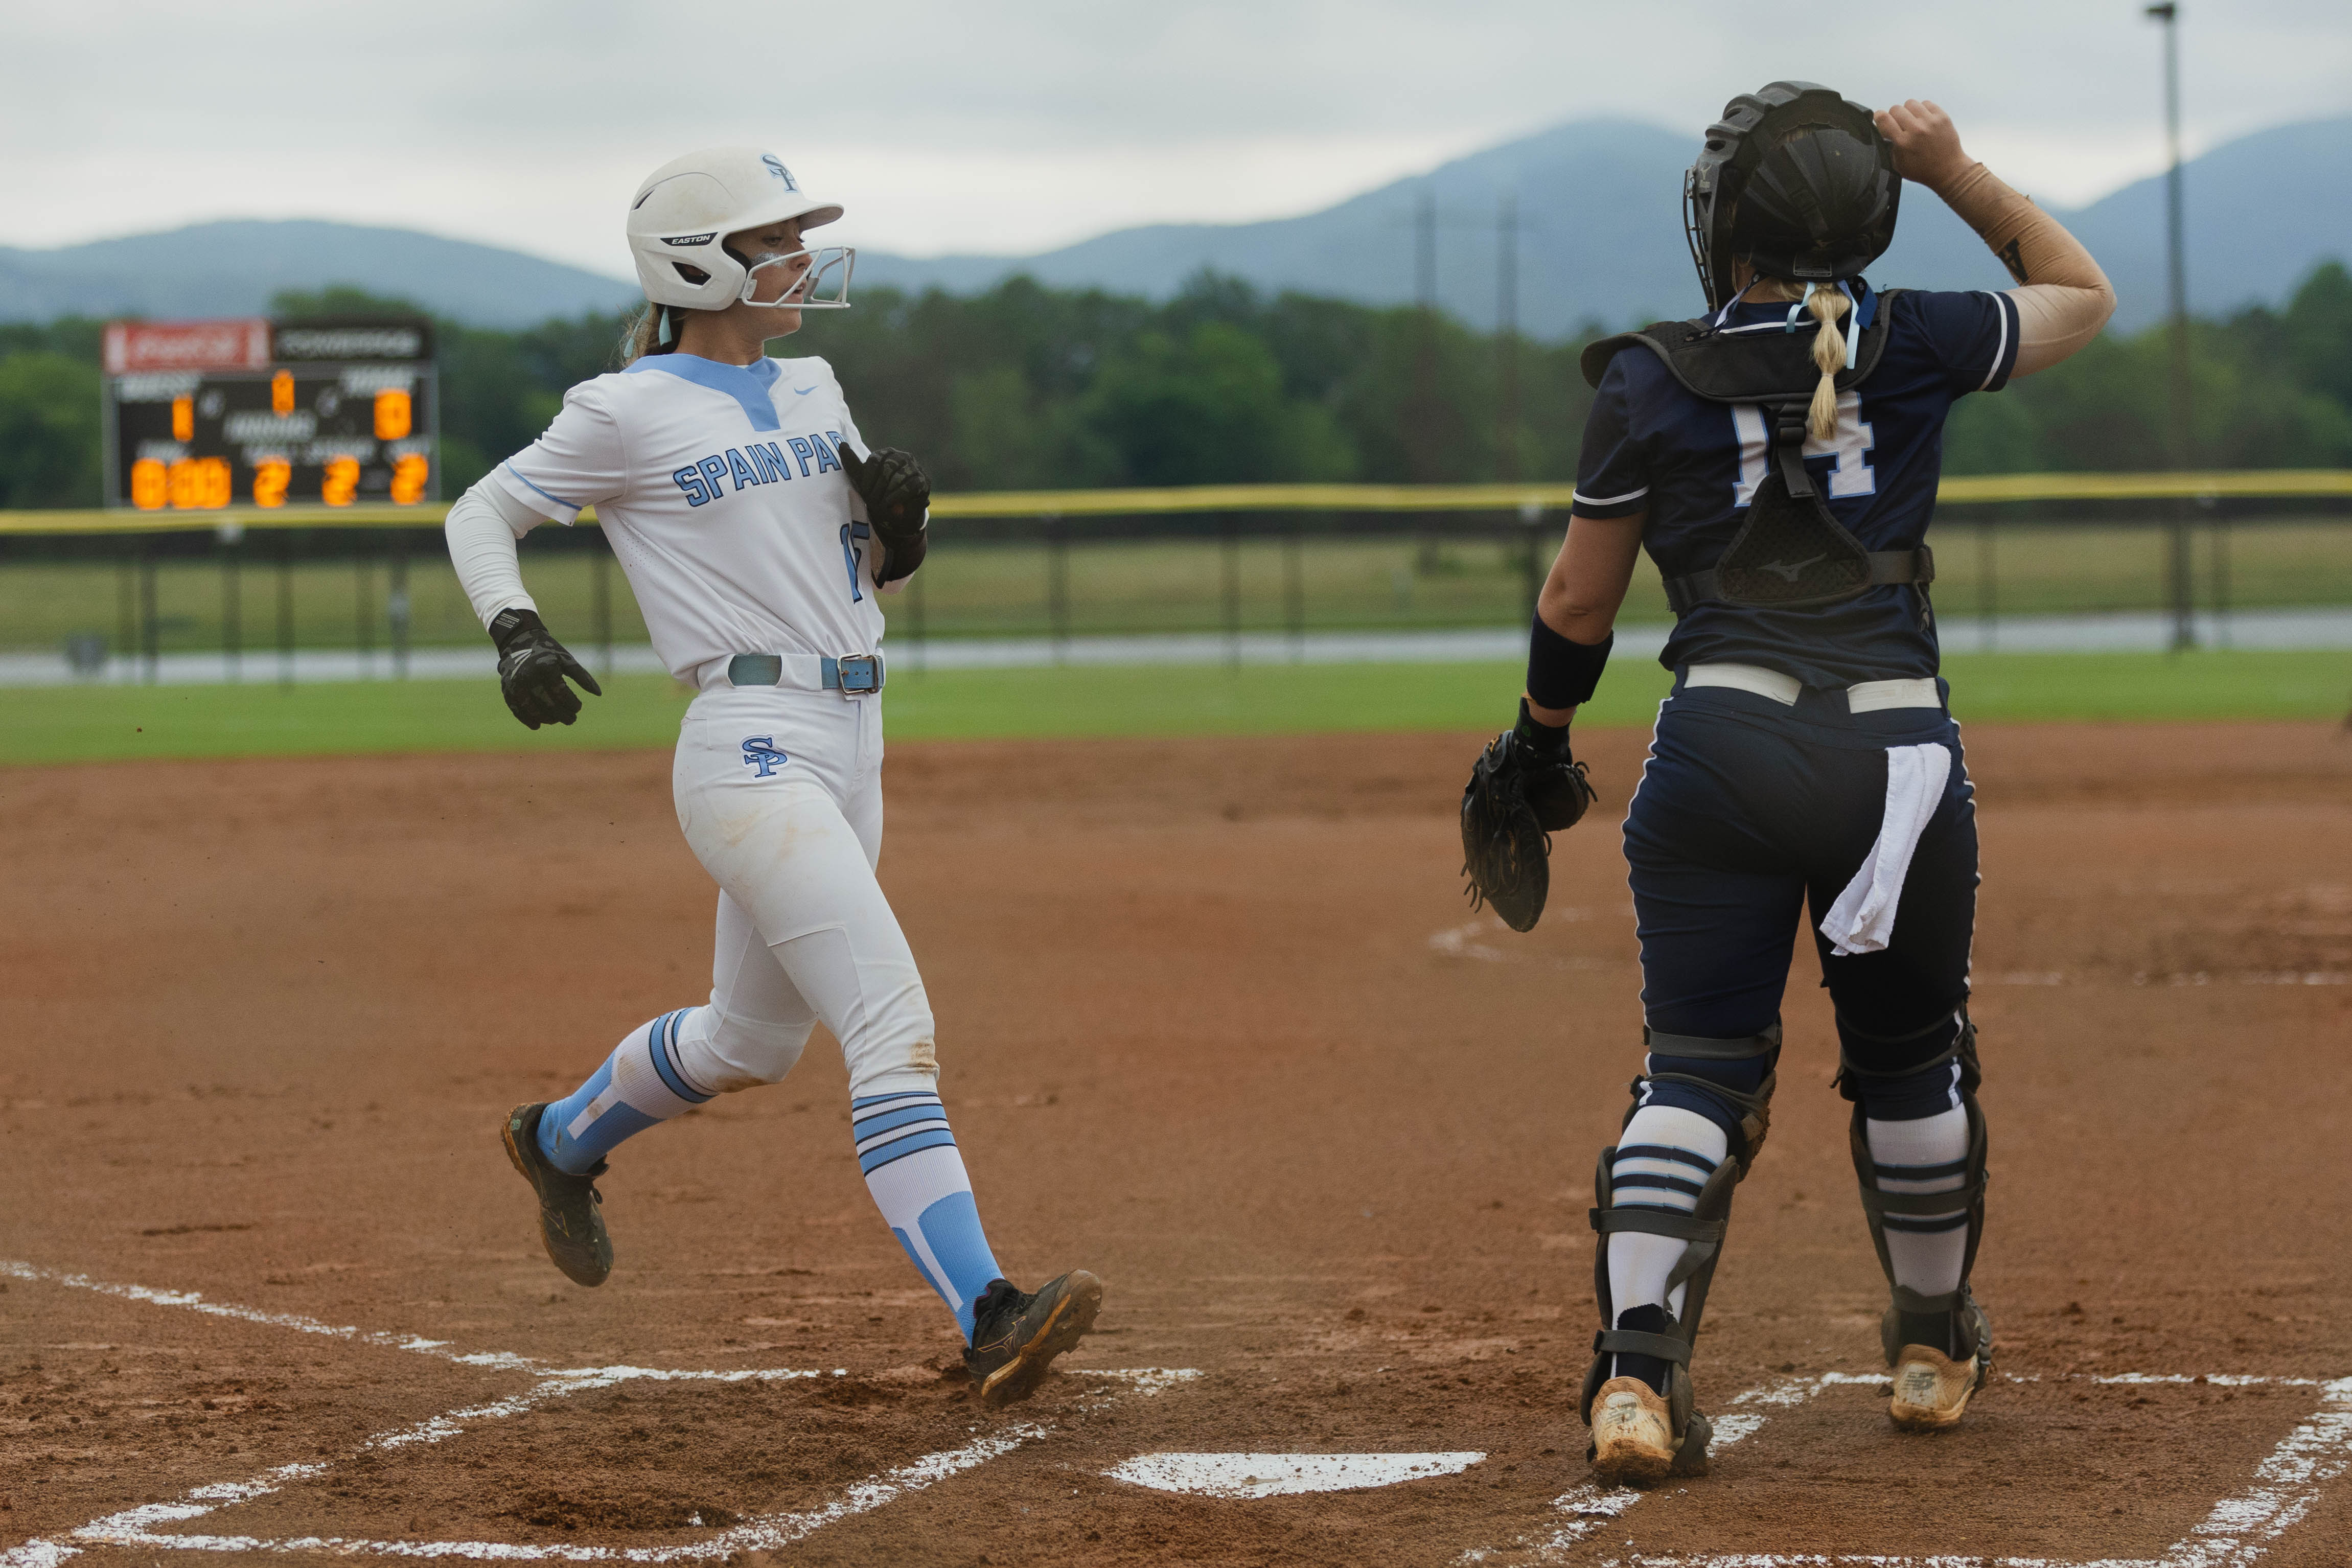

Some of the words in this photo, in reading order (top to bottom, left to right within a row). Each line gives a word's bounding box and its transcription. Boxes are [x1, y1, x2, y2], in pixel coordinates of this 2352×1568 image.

[671, 235, 710, 244] EASTON
[673, 442, 792, 507] SPAIN
[1731, 390, 1876, 508] 14
[742, 737, 788, 778] SP
